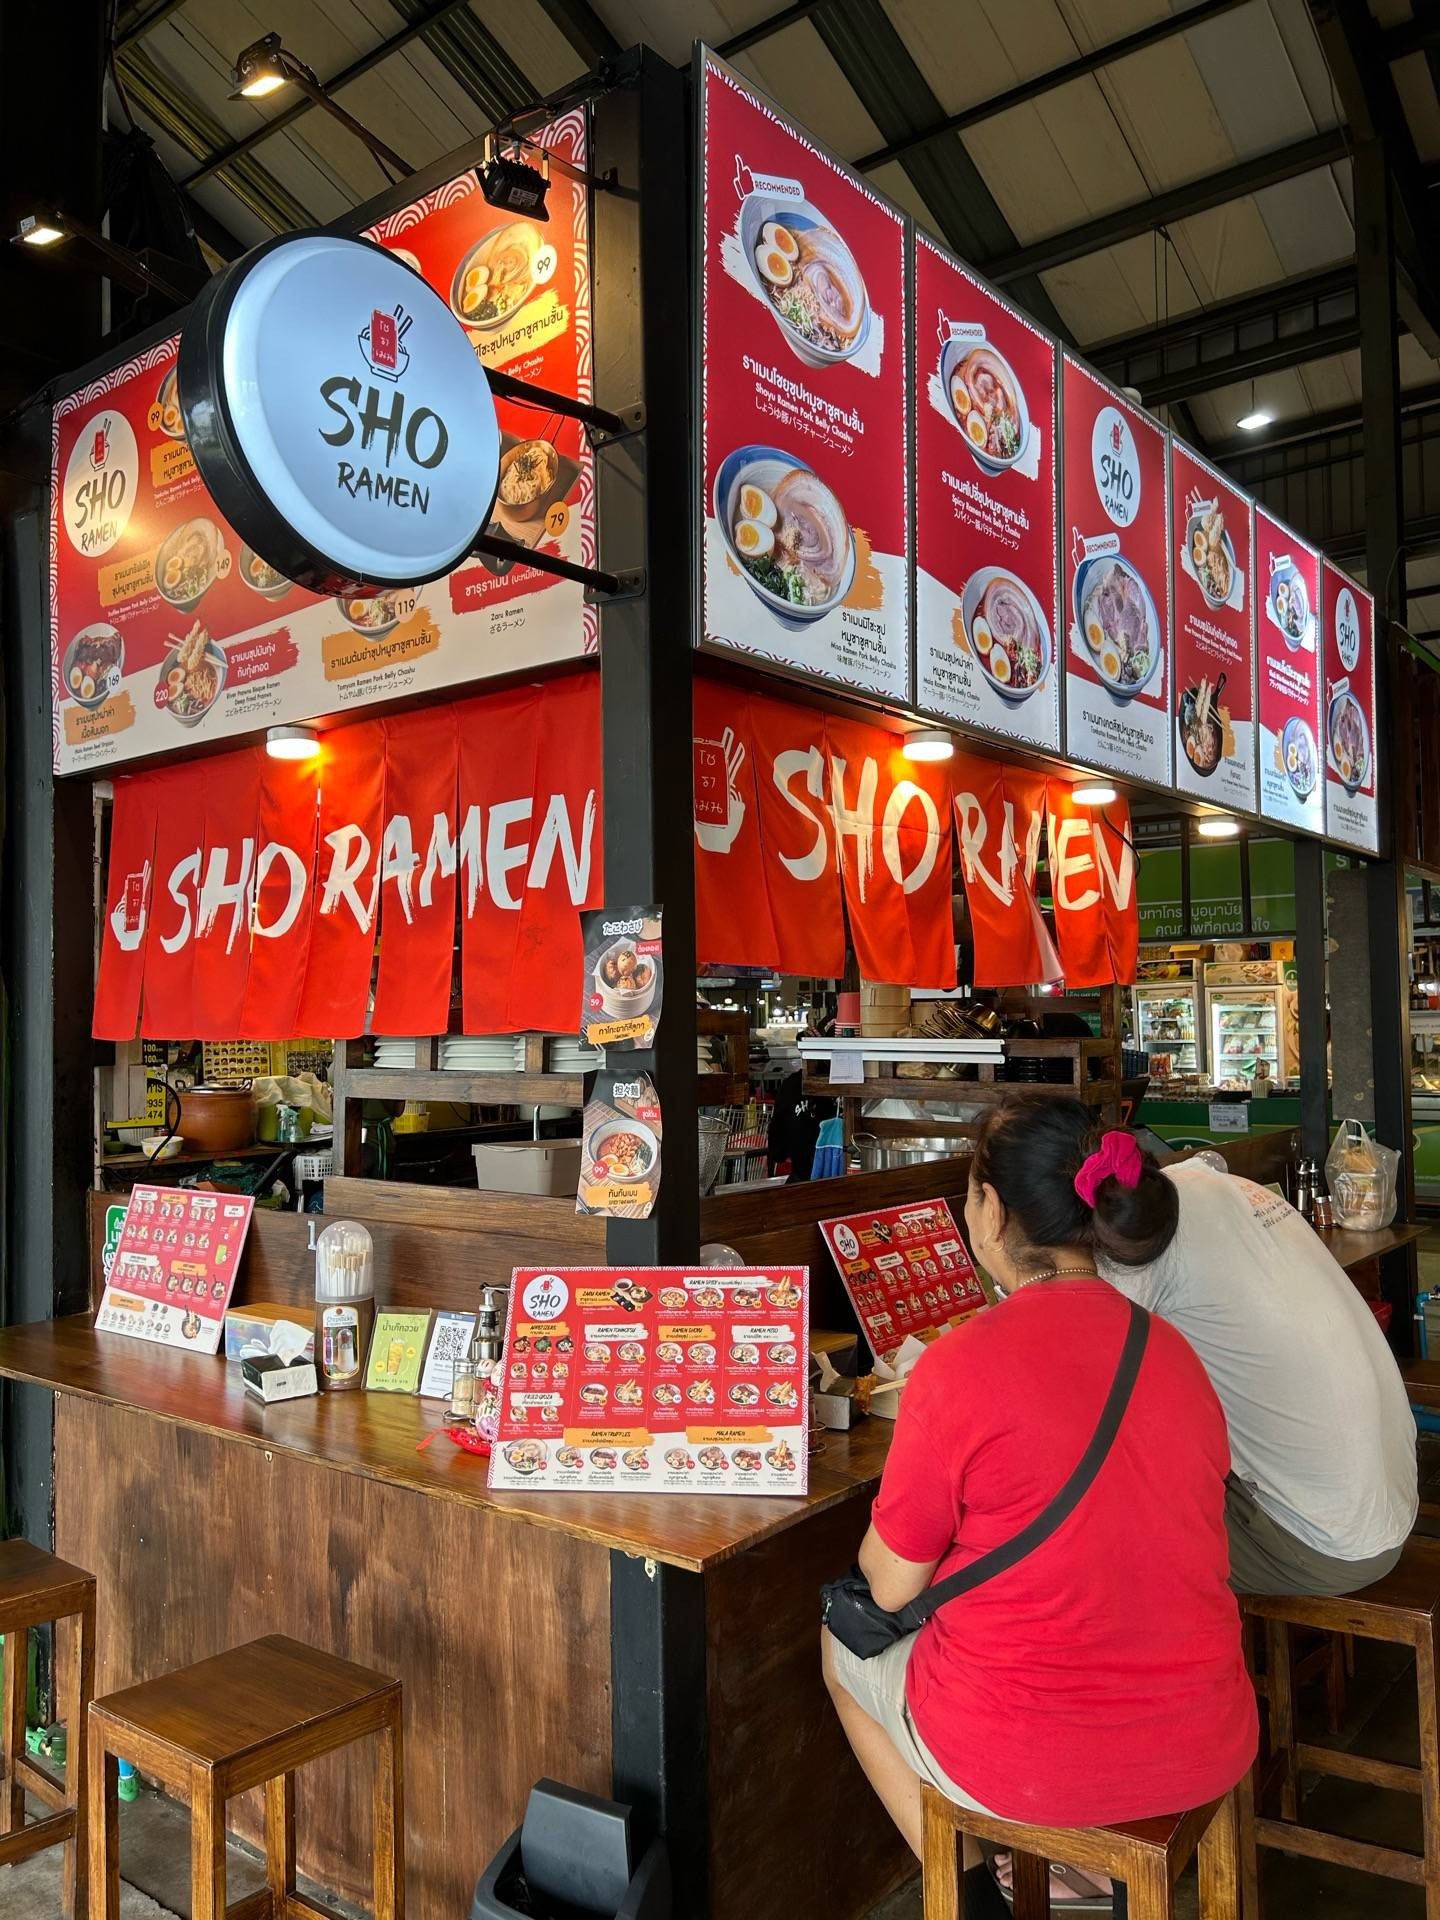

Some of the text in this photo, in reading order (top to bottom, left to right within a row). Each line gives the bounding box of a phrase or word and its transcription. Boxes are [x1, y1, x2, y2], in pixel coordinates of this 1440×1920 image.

[755, 180, 801, 196] RECOMMENDED
[537, 256, 551, 273] 99
[951, 327, 984, 337] RECOMMENDED
[523, 355, 544, 369] Chashu
[150, 411, 160, 424] 99
[755, 382, 854, 444] Shoyu Ramen Pork Belly Chashu
[318, 376, 449, 469] SHO
[1099, 452, 1134, 501] SHO
[336, 462, 430, 514] RAMEN
[75, 469, 126, 529] SHO
[951, 494, 1021, 540] Spicy Ramen Pork Belly Chashu
[1104, 495, 1130, 523] RAMEN
[550, 511, 565, 527] 79
[81, 521, 118, 552] RAMEN
[1086, 539, 1118, 552] RECOMMENDED
[216, 558, 230, 573] 149
[397, 599, 415, 615] 119
[490, 607, 524, 621] Zaru Ramen
[489, 617, 527, 635] ざるラーメン
[1339, 623, 1356, 649] SHO
[842, 645, 858, 656] Ramen
[858, 650, 868, 660] Pork
[869, 654, 880, 665] Belly
[880, 658, 897, 670] Chashu
[108, 674, 121, 687] 169
[356, 677, 372, 687] Ramen
[372, 674, 383, 684] Pork
[384, 669, 396, 681] Belly
[397, 666, 417, 677] Chashu
[266, 681, 281, 690] Ramen
[155, 688, 169, 703] 220
[772, 745, 940, 904] SHO
[159, 789, 597, 954] SHO RAMEN
[839, 1238, 856, 1252] SHO
[529, 1294, 561, 1309] SHO
[532, 1310, 555, 1318] RAMEN
